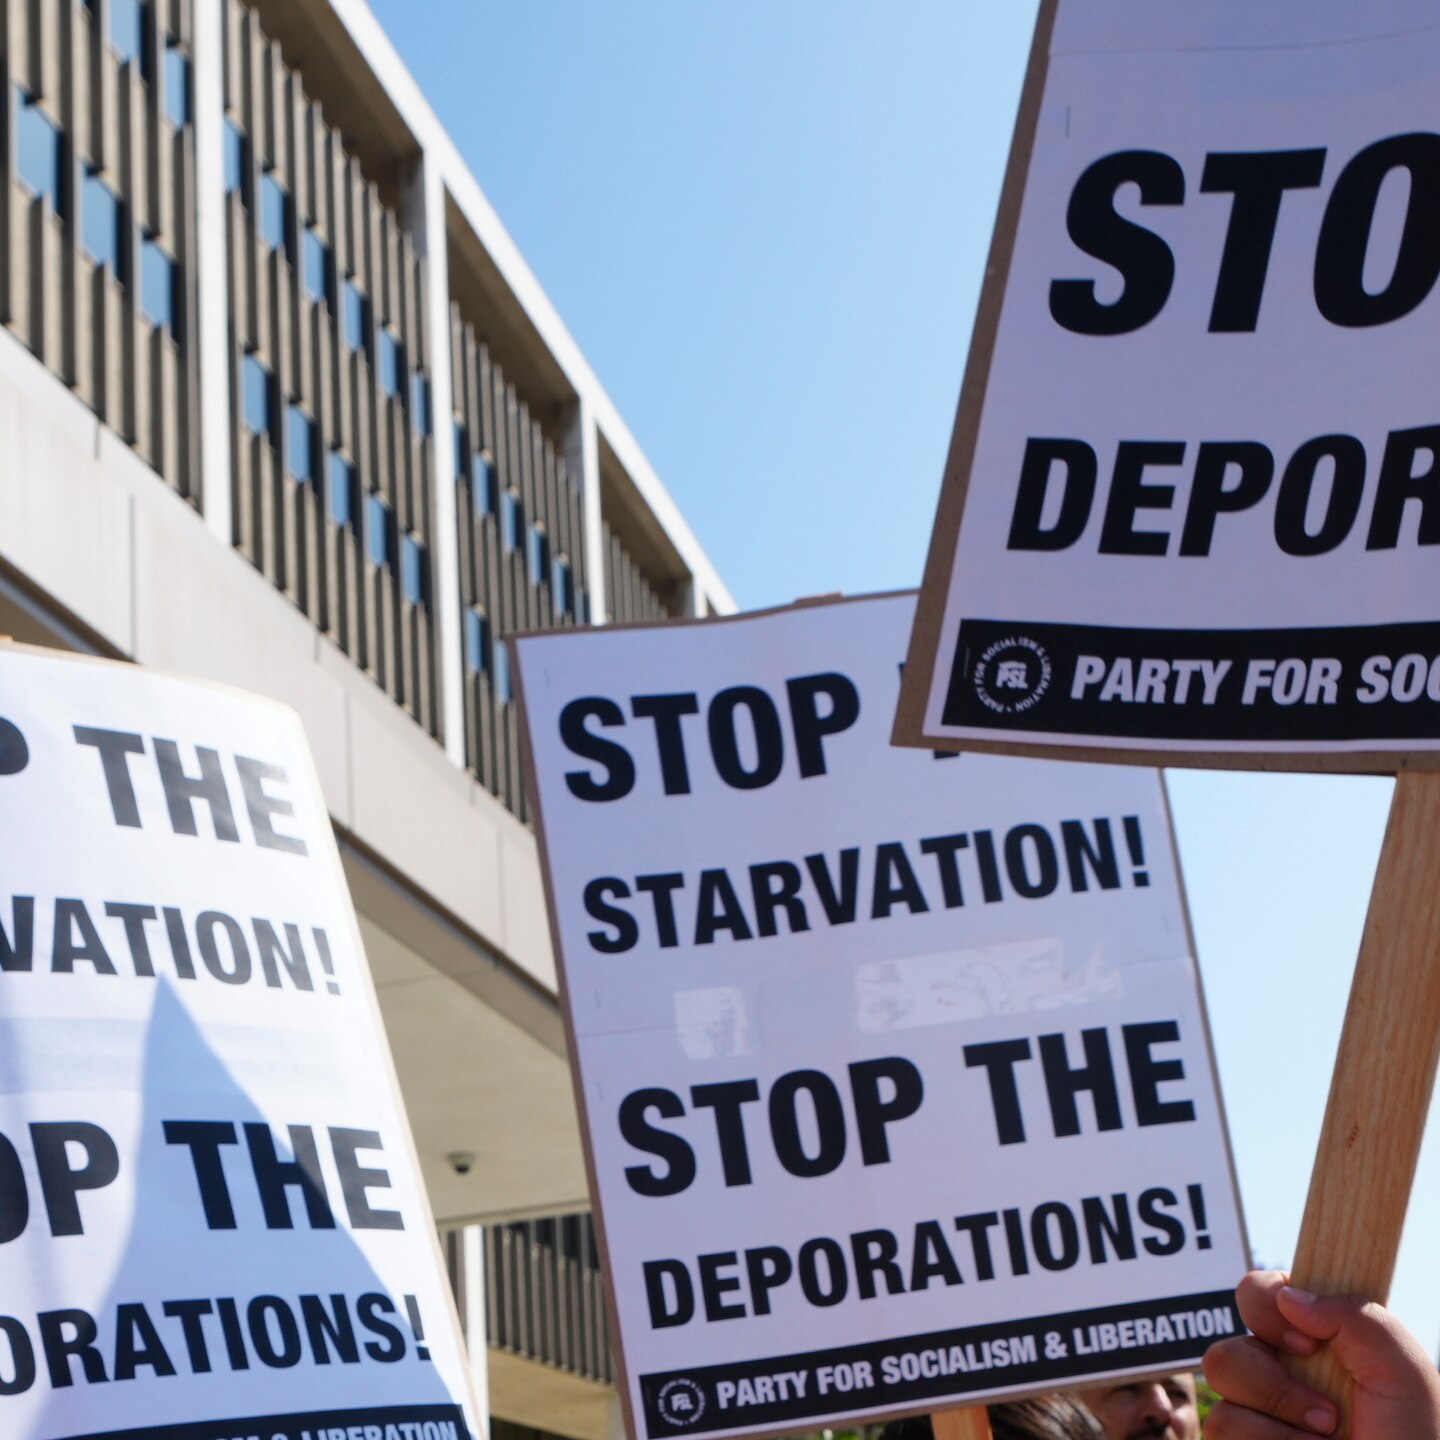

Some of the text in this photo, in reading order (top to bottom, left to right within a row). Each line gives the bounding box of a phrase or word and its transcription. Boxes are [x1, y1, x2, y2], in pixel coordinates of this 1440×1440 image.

[558, 672, 860, 803] STOP
[1070, 655, 1233, 705] PARTY
[1241, 658, 1342, 706] FOR
[71, 723, 310, 858] THE
[582, 815, 1150, 954] STARVATION!
[160, 1119, 404, 1231] THE
[618, 1020, 1197, 1198] STOP THE
[641, 1183, 1213, 1330] DEPORATIONS!
[716, 1369, 808, 1410] PARTY
[816, 1360, 875, 1395] FOR
[882, 1334, 1038, 1384] SOCIALISM
[1044, 1331, 1068, 1360] &
[1074, 1307, 1235, 1356] LIBERATION
